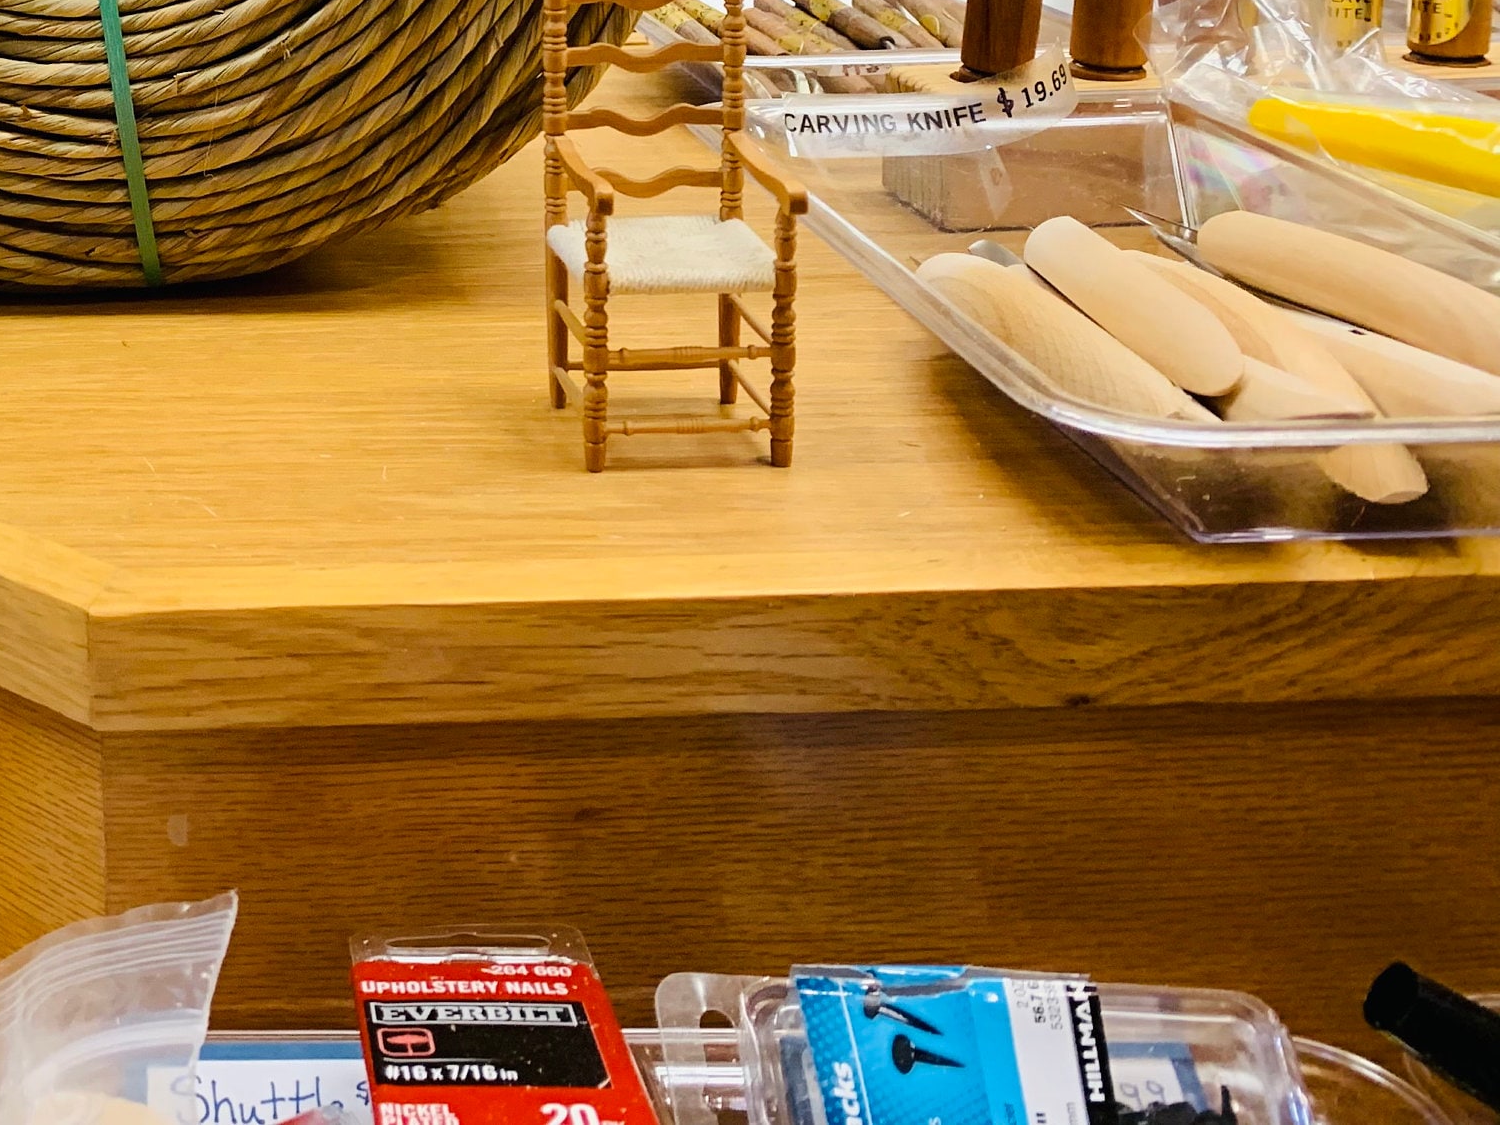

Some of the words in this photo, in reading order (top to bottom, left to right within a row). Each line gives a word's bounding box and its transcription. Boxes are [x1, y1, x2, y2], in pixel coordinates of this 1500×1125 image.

[785, 112, 897, 134] CARVING
[906, 102, 987, 131] KNIFE
[996, 87, 1014, 118] $
[1021, 63, 1069, 107] 19.69
[361, 979, 498, 995] UPHOLSTERY
[505, 980, 569, 996] NAILS
[378, 1004, 564, 1023] EVERBILT
[384, 1064, 428, 1081] #16
[430, 1067, 445, 1081] x
[447, 1064, 498, 1081] 7/16
[500, 1068, 519, 1082] in
[379, 1102, 452, 1116] NICKEL
[540, 1103, 601, 1125] 20
